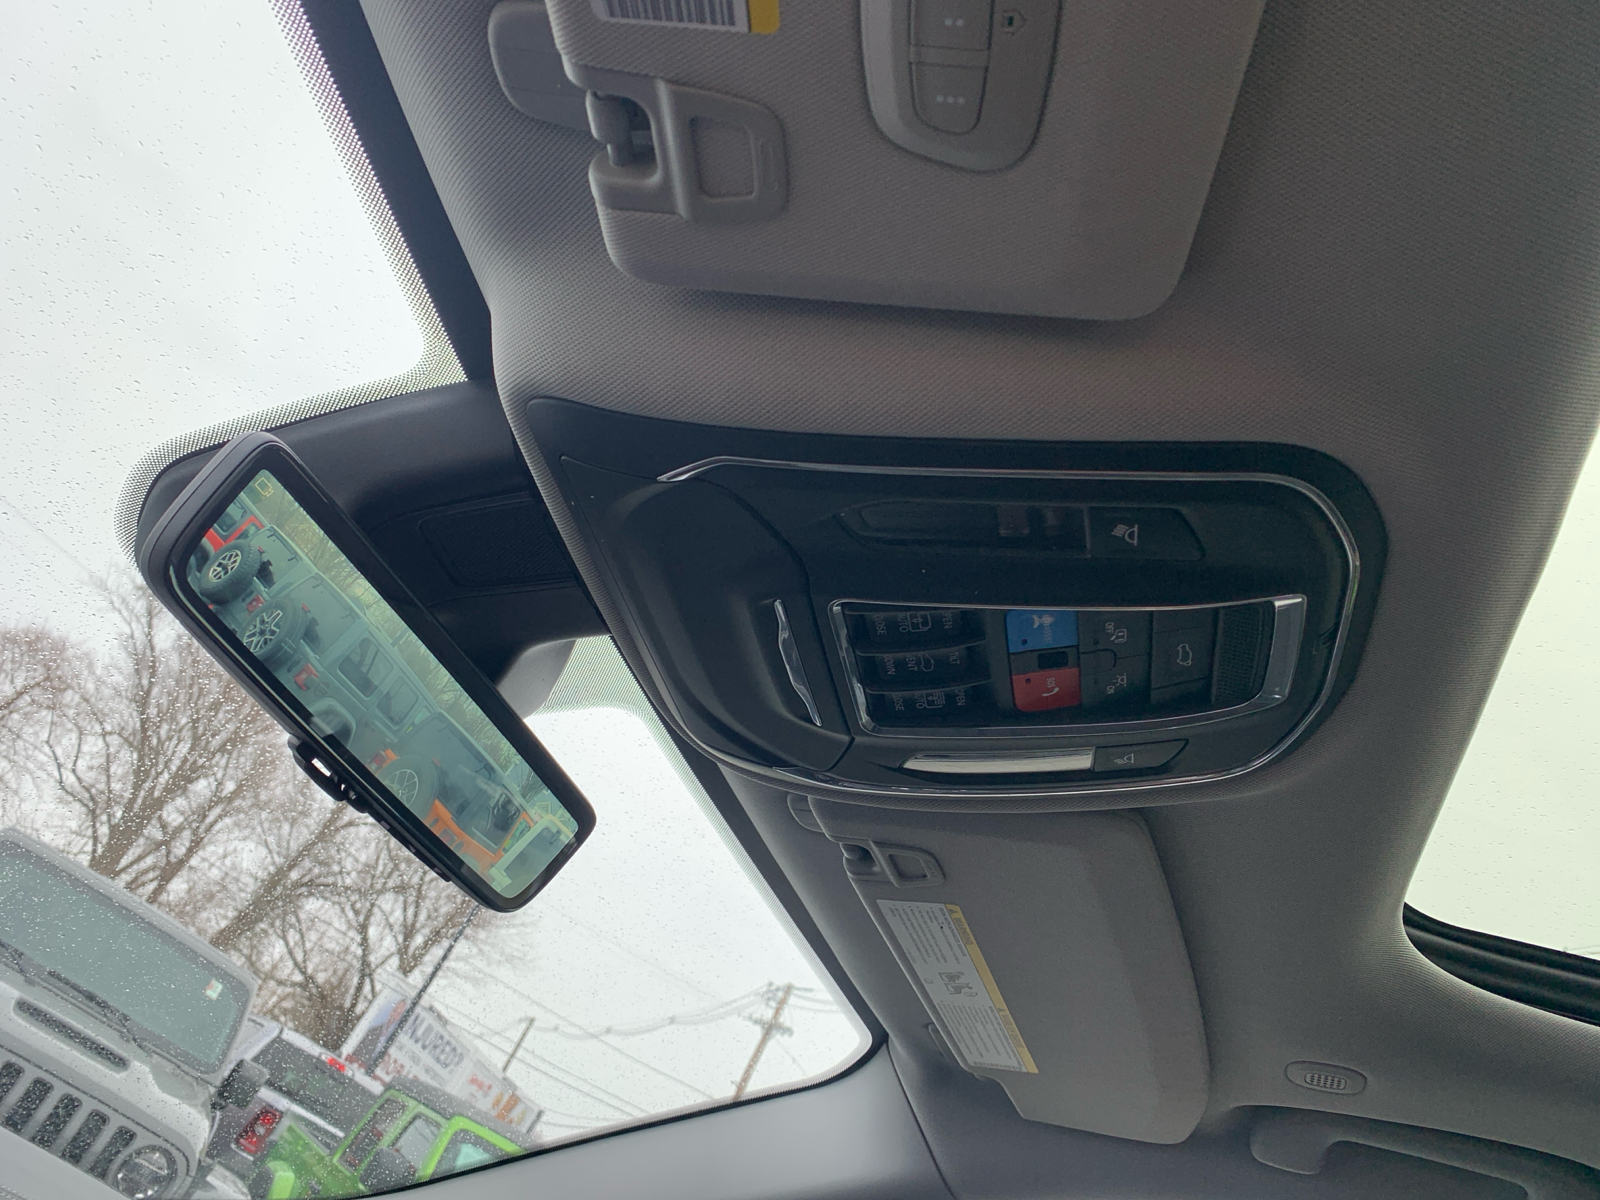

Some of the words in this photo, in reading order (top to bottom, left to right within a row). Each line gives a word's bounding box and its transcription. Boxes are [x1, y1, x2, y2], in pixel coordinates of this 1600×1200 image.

[942, 610, 953, 629] PEN
[1105, 622, 1114, 633] OFF
[1047, 677, 1055, 688] SOS
[1107, 685, 1115, 694] ON
[953, 917, 974, 945] WARNING
[401, 1010, 466, 1075] NJURED?
